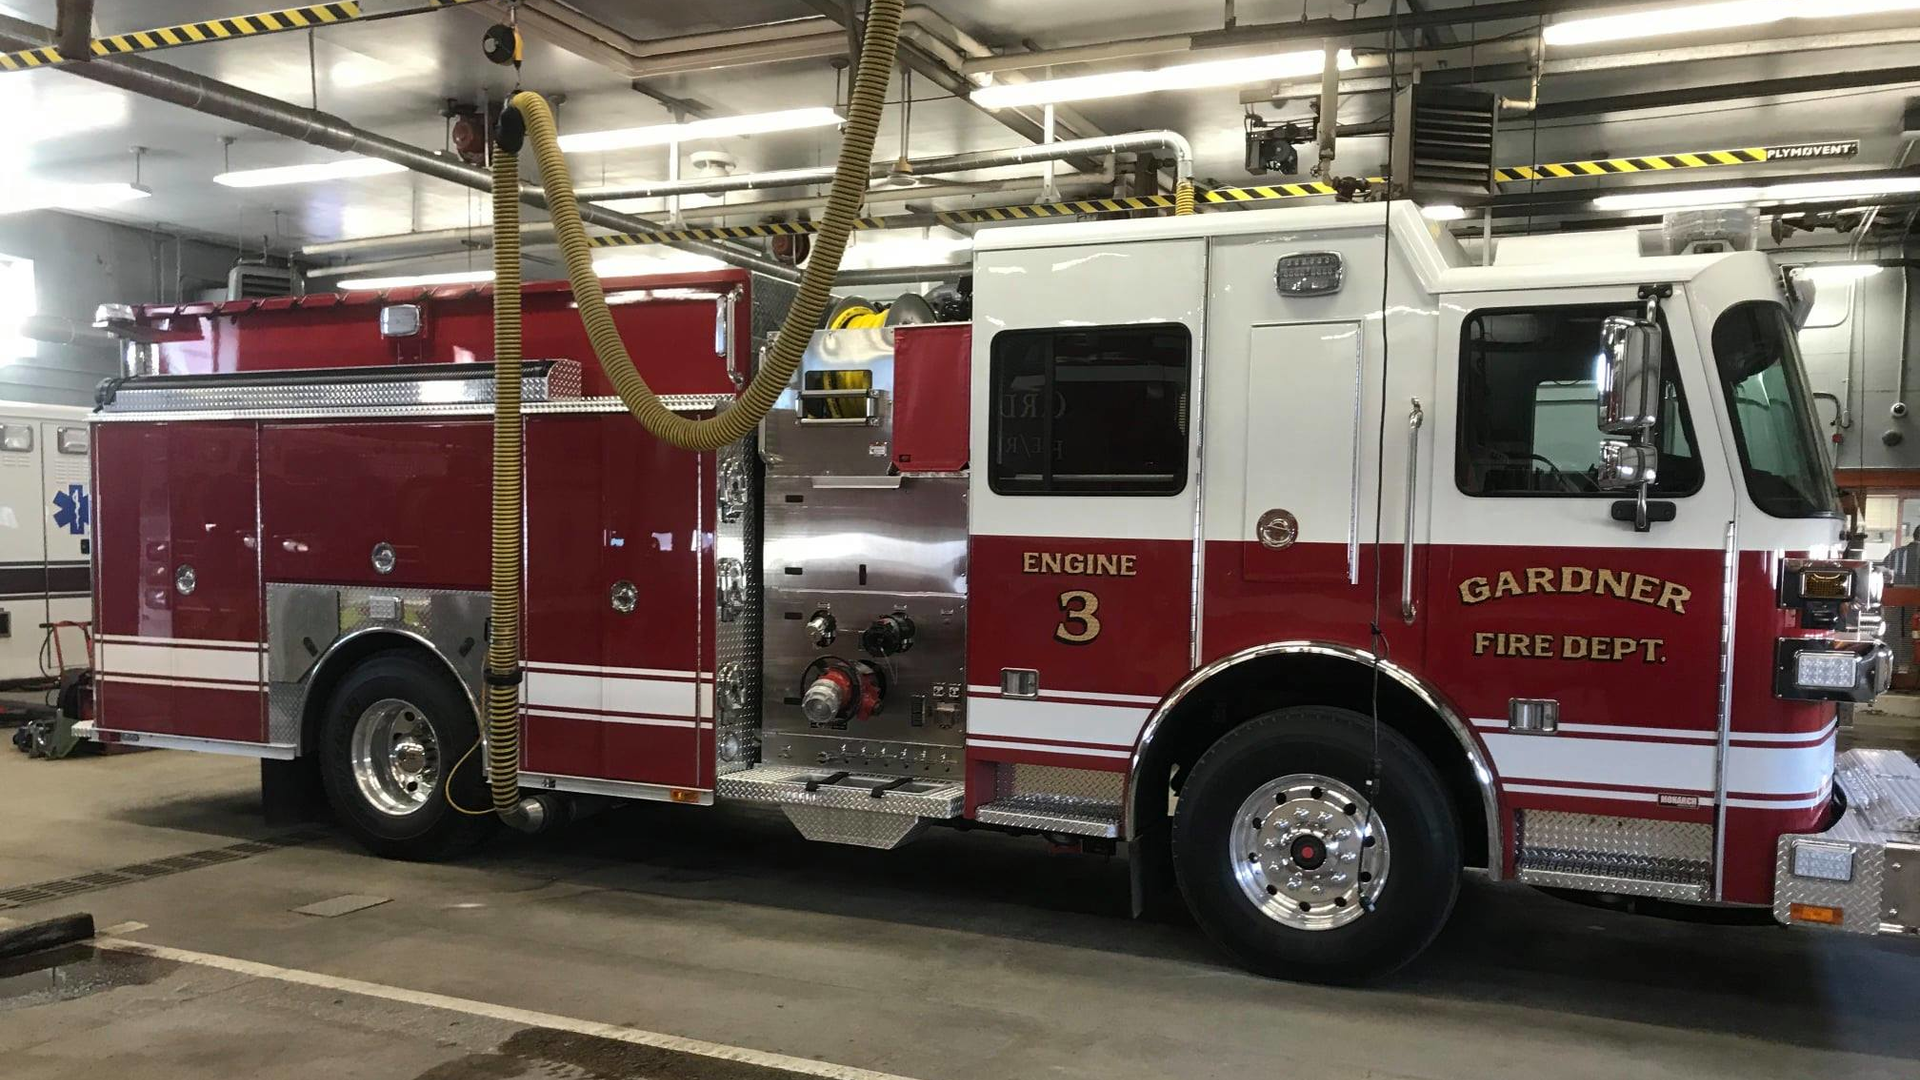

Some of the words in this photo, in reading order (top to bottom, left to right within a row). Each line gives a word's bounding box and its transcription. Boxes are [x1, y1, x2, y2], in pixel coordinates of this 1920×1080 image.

[1767, 143, 1851, 159] PLYMOVENT
[1022, 551, 1138, 577] ENGINE
[1458, 565, 1693, 615] GARDNER
[1055, 589, 1102, 645] 3
[1474, 632, 1555, 658] FIRE
[1562, 635, 1668, 663] DEPT.
